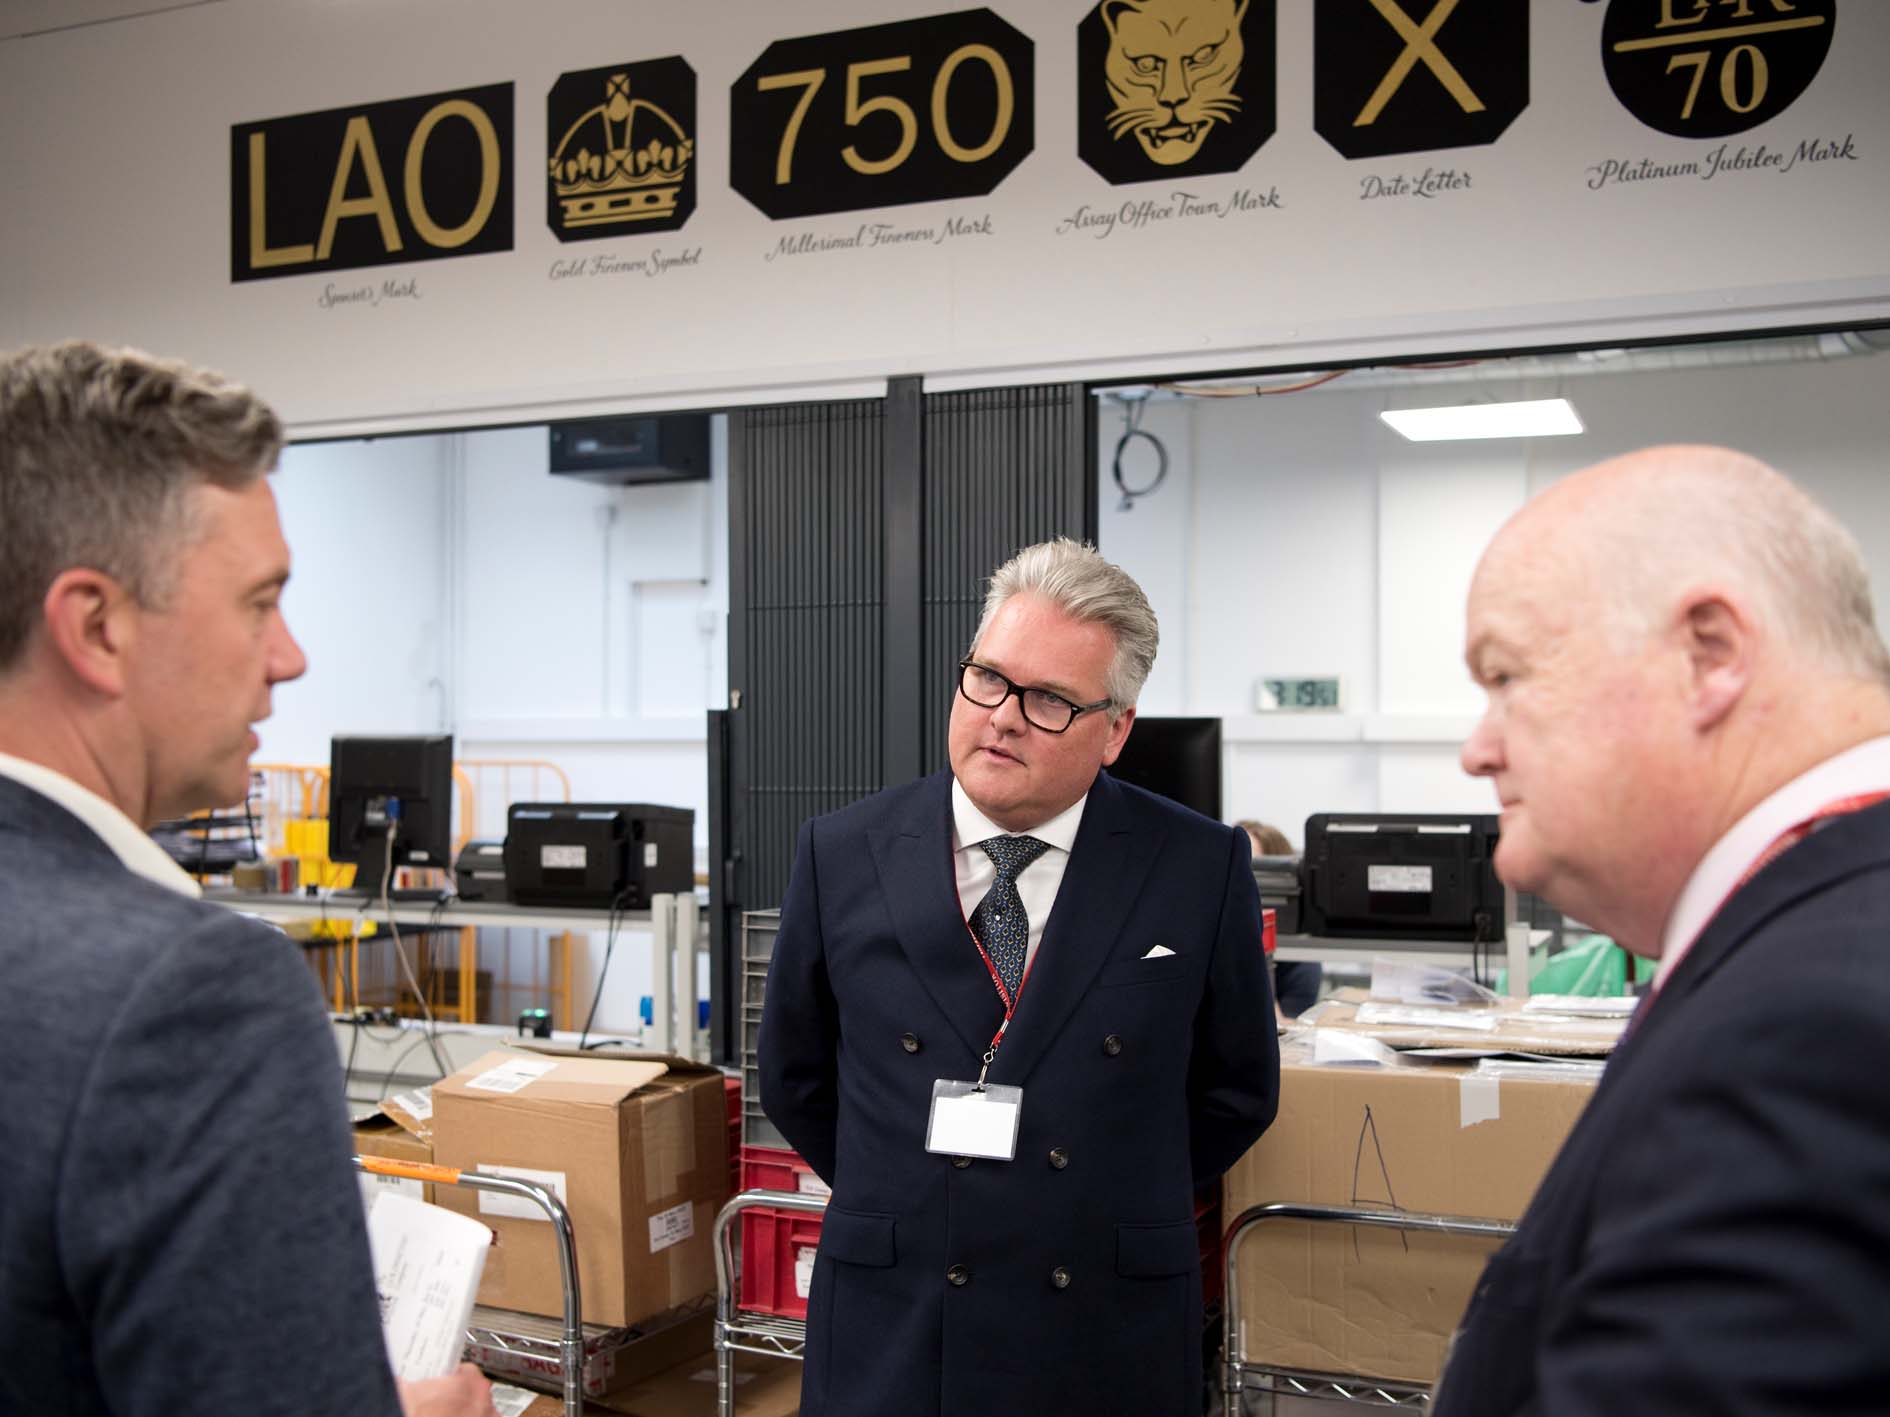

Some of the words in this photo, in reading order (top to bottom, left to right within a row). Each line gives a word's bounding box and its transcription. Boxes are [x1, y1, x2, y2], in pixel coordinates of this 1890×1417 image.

[1353, 0, 1487, 127] X
[1665, 44, 1769, 120] 70
[757, 43, 1015, 186] 750
[249, 99, 501, 269] LAO
[1360, 174, 1410, 200] Date
[1412, 167, 1472, 199] Letter
[1586, 158, 1699, 190] Platinum
[1700, 143, 1783, 180] Jubilee
[1779, 134, 1859, 173] Mark
[764, 224, 867, 263] Millesimal
[868, 223, 935, 247] Fineness
[933, 214, 994, 245] Mark
[1056, 205, 1119, 239] Assay
[1119, 199, 1174, 228] Office
[1170, 191, 1221, 218] Town
[1218, 186, 1285, 218] Mark
[549, 259, 586, 280] Gold
[589, 255, 647, 277] Fineness
[645, 247, 702, 278] Symbol
[371, 278, 422, 306] Mark
